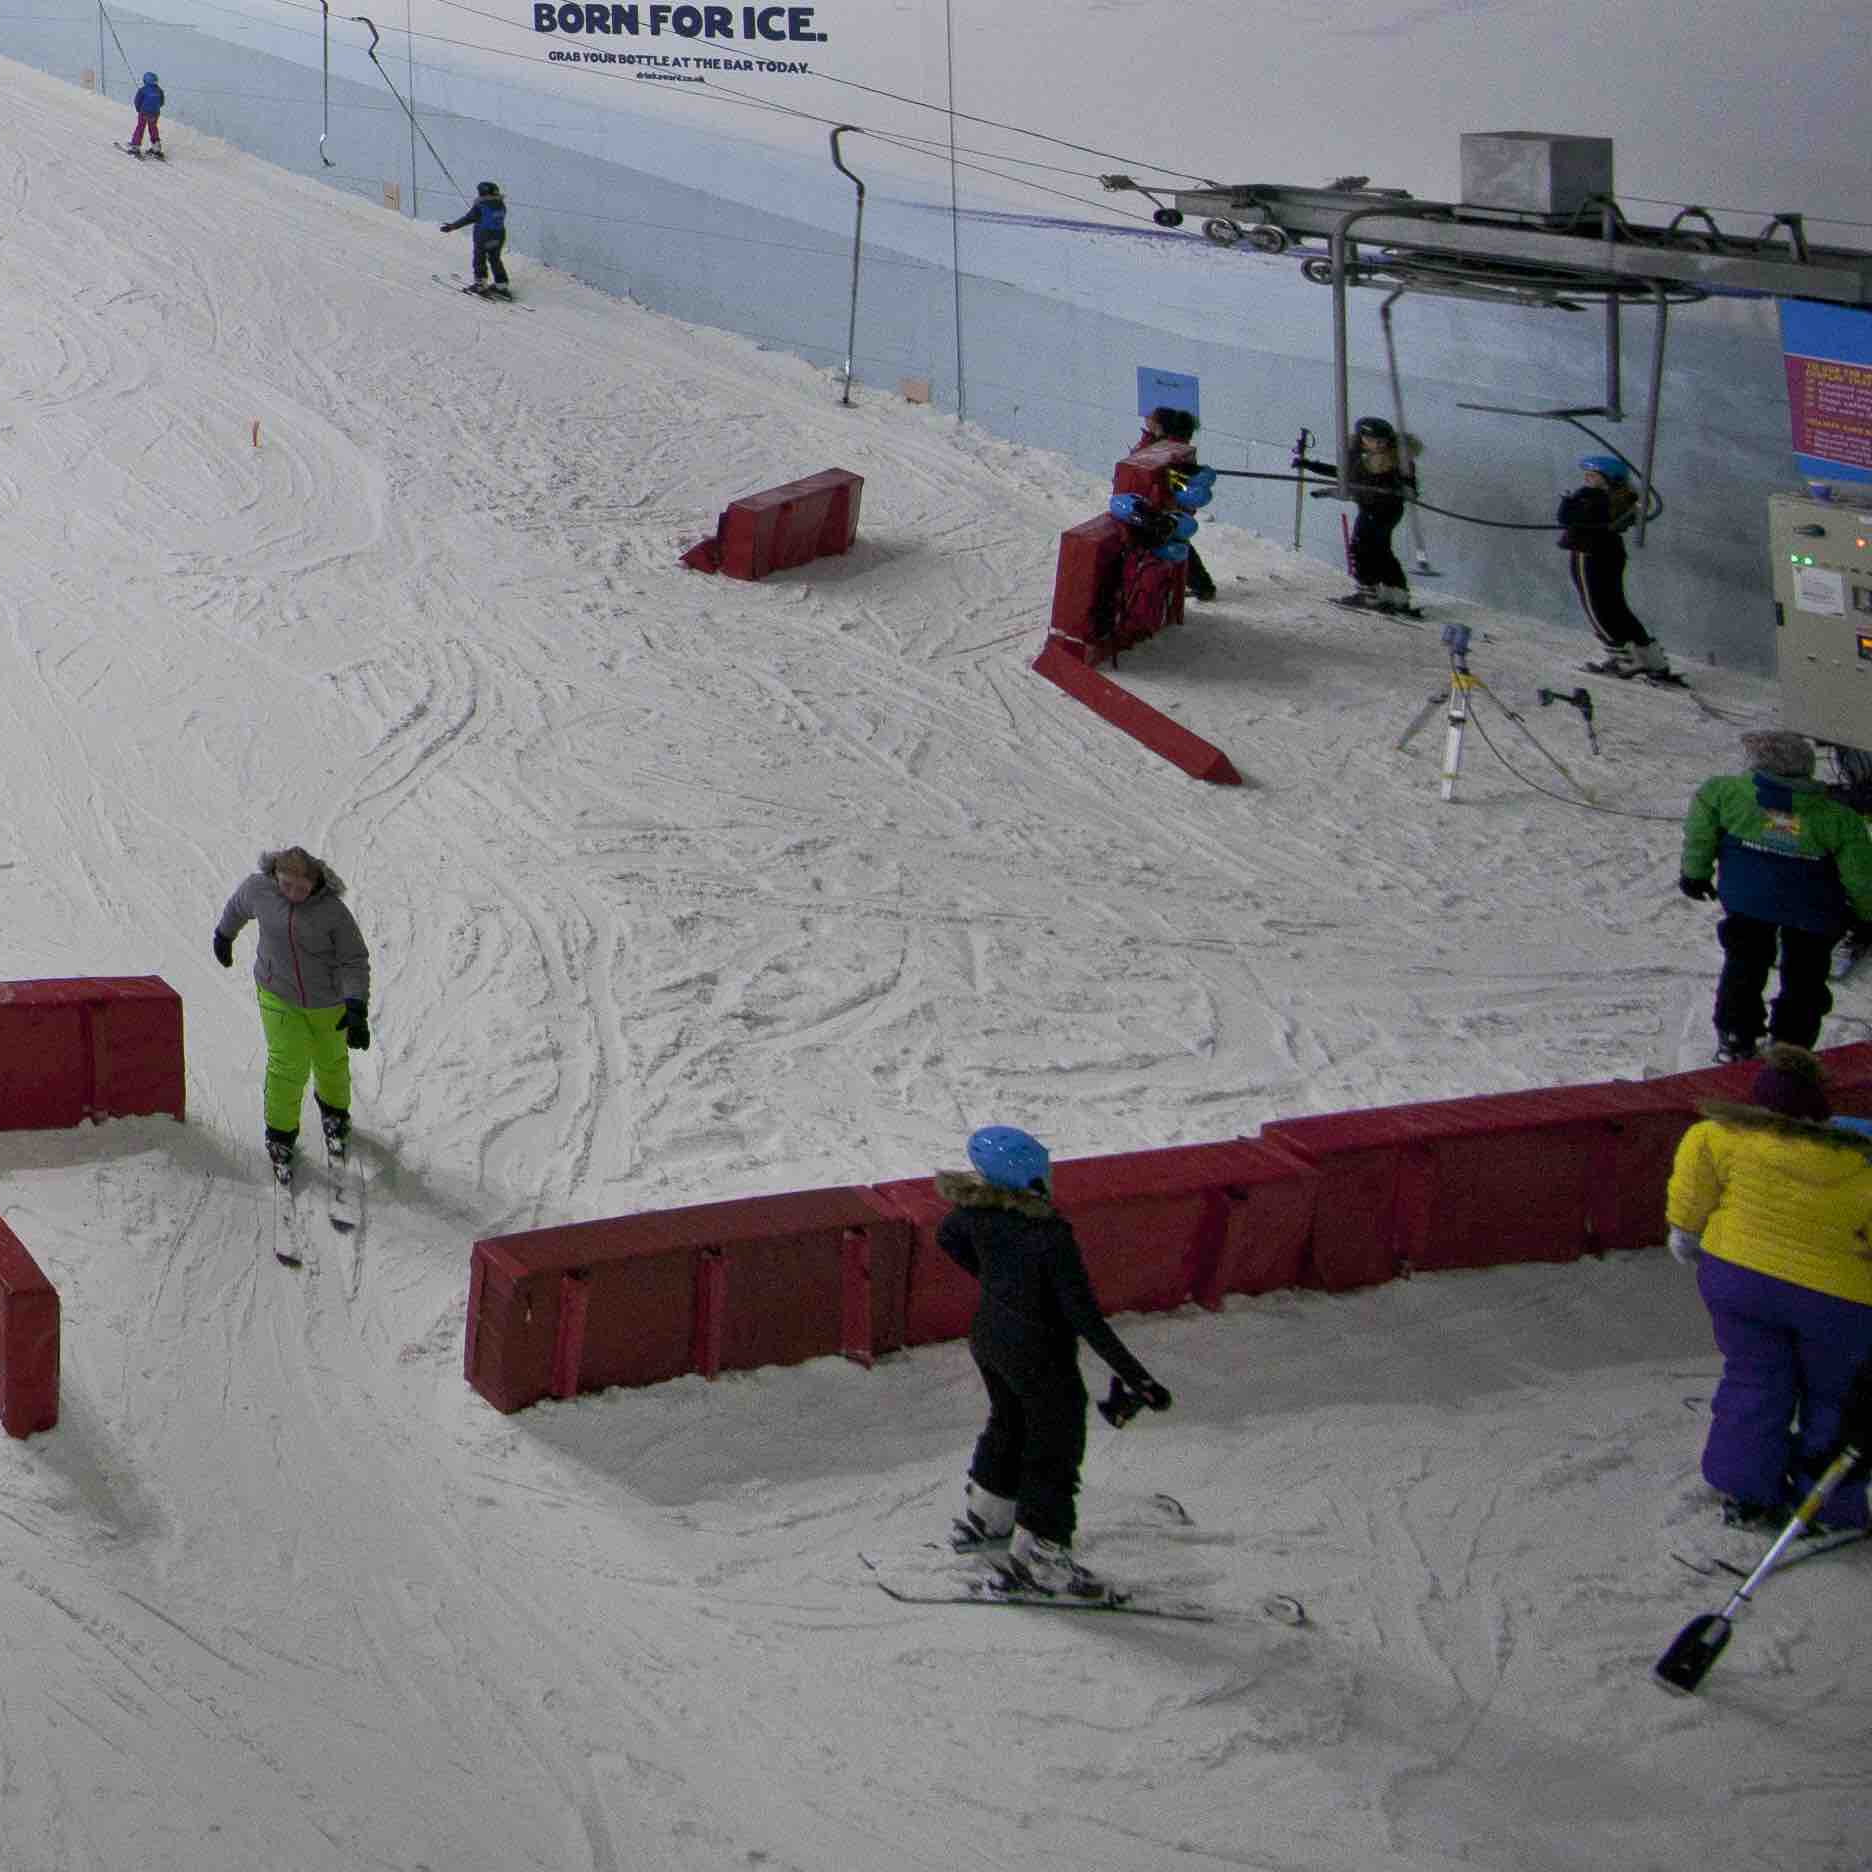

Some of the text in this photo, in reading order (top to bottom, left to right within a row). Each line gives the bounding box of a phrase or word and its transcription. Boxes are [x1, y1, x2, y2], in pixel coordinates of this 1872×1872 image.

[533, 1, 828, 42] BORN FOR ICE.
[548, 50, 814, 74] GRAB YOUR BOTTLE AT THE BAR TODAY.
